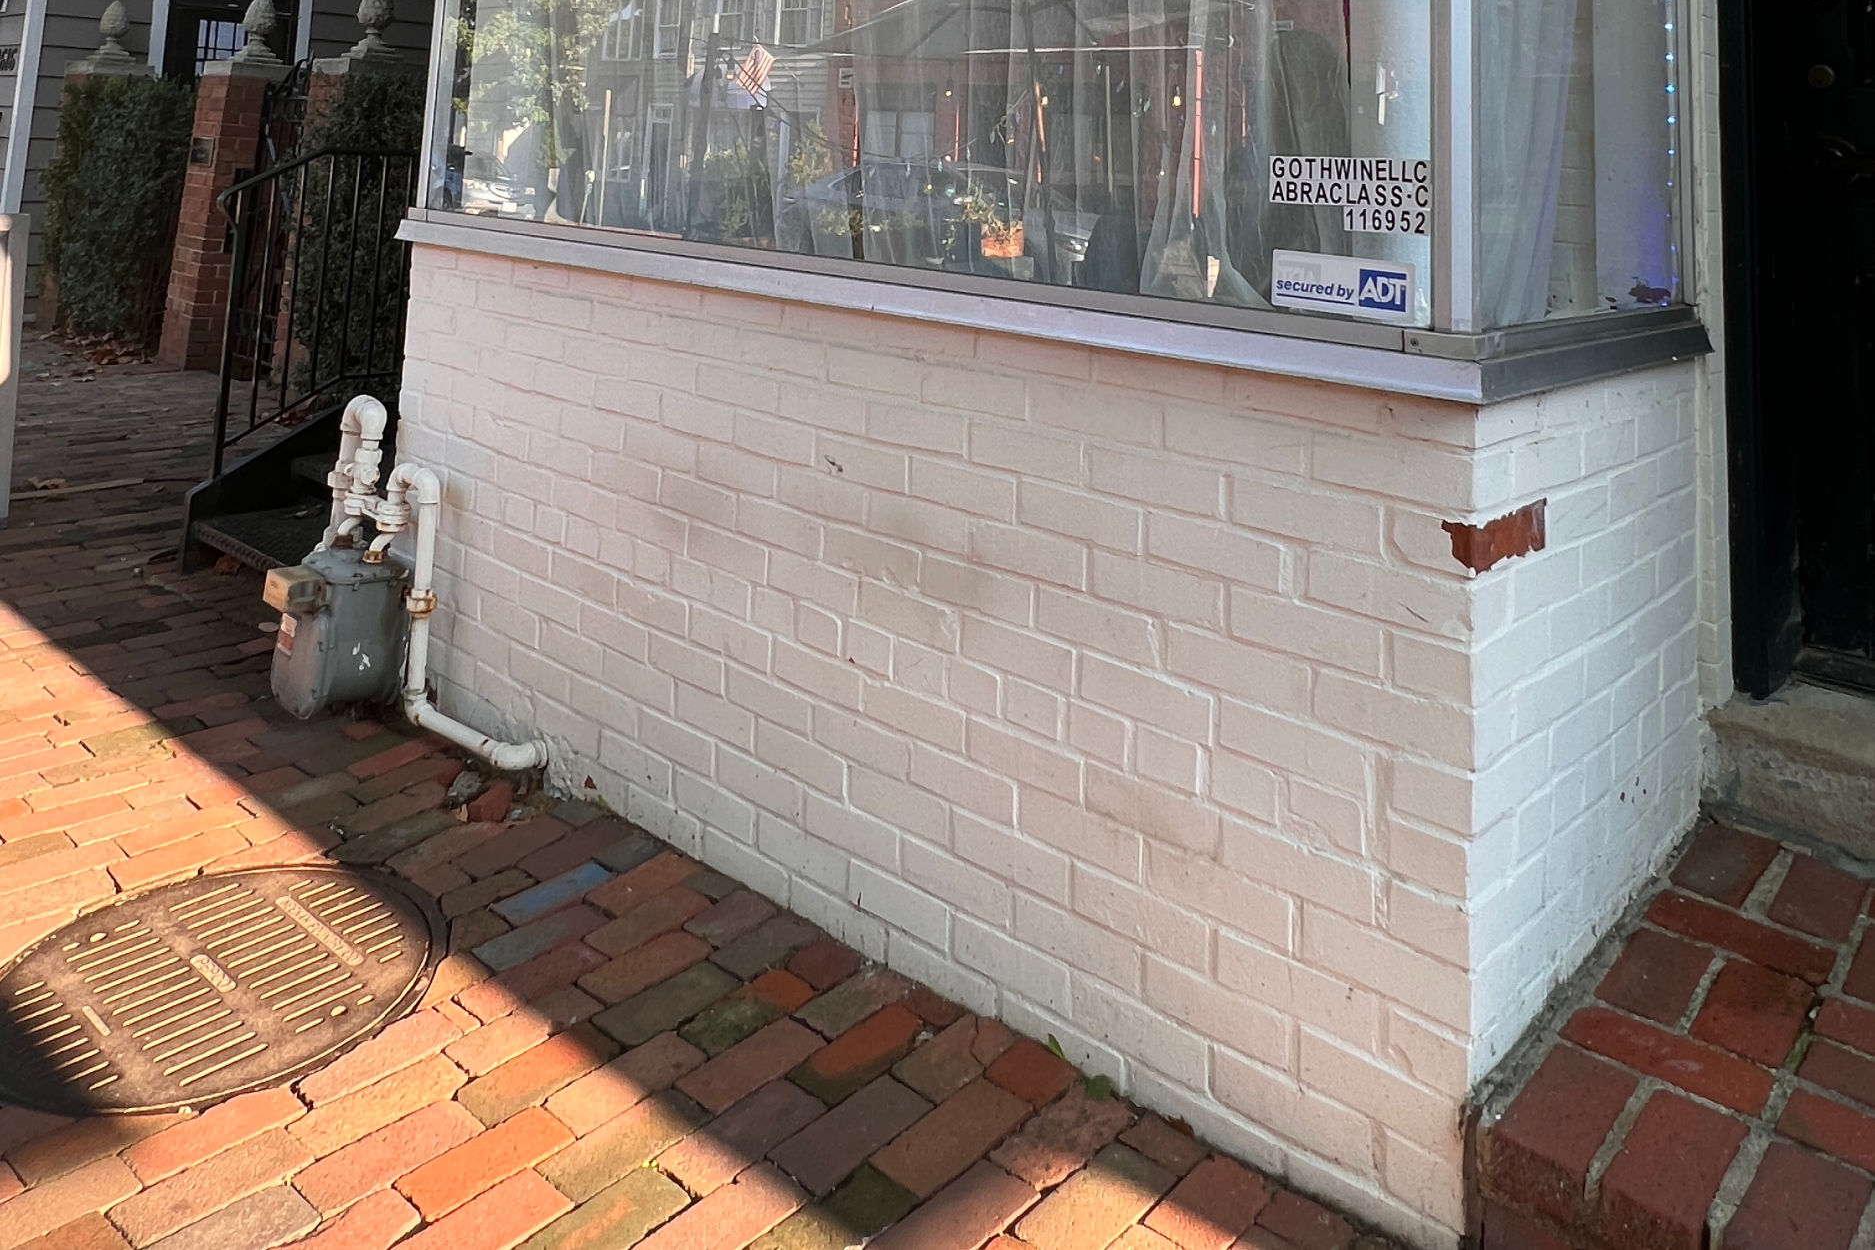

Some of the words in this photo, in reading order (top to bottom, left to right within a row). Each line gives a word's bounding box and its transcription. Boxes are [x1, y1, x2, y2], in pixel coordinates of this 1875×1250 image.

[1271, 157, 1428, 184] GOTHWINELLC
[1345, 208, 1426, 234] 116952
[1276, 279, 1335, 296] secured
[1336, 284, 1355, 301] by
[1359, 275, 1407, 306] ADT
